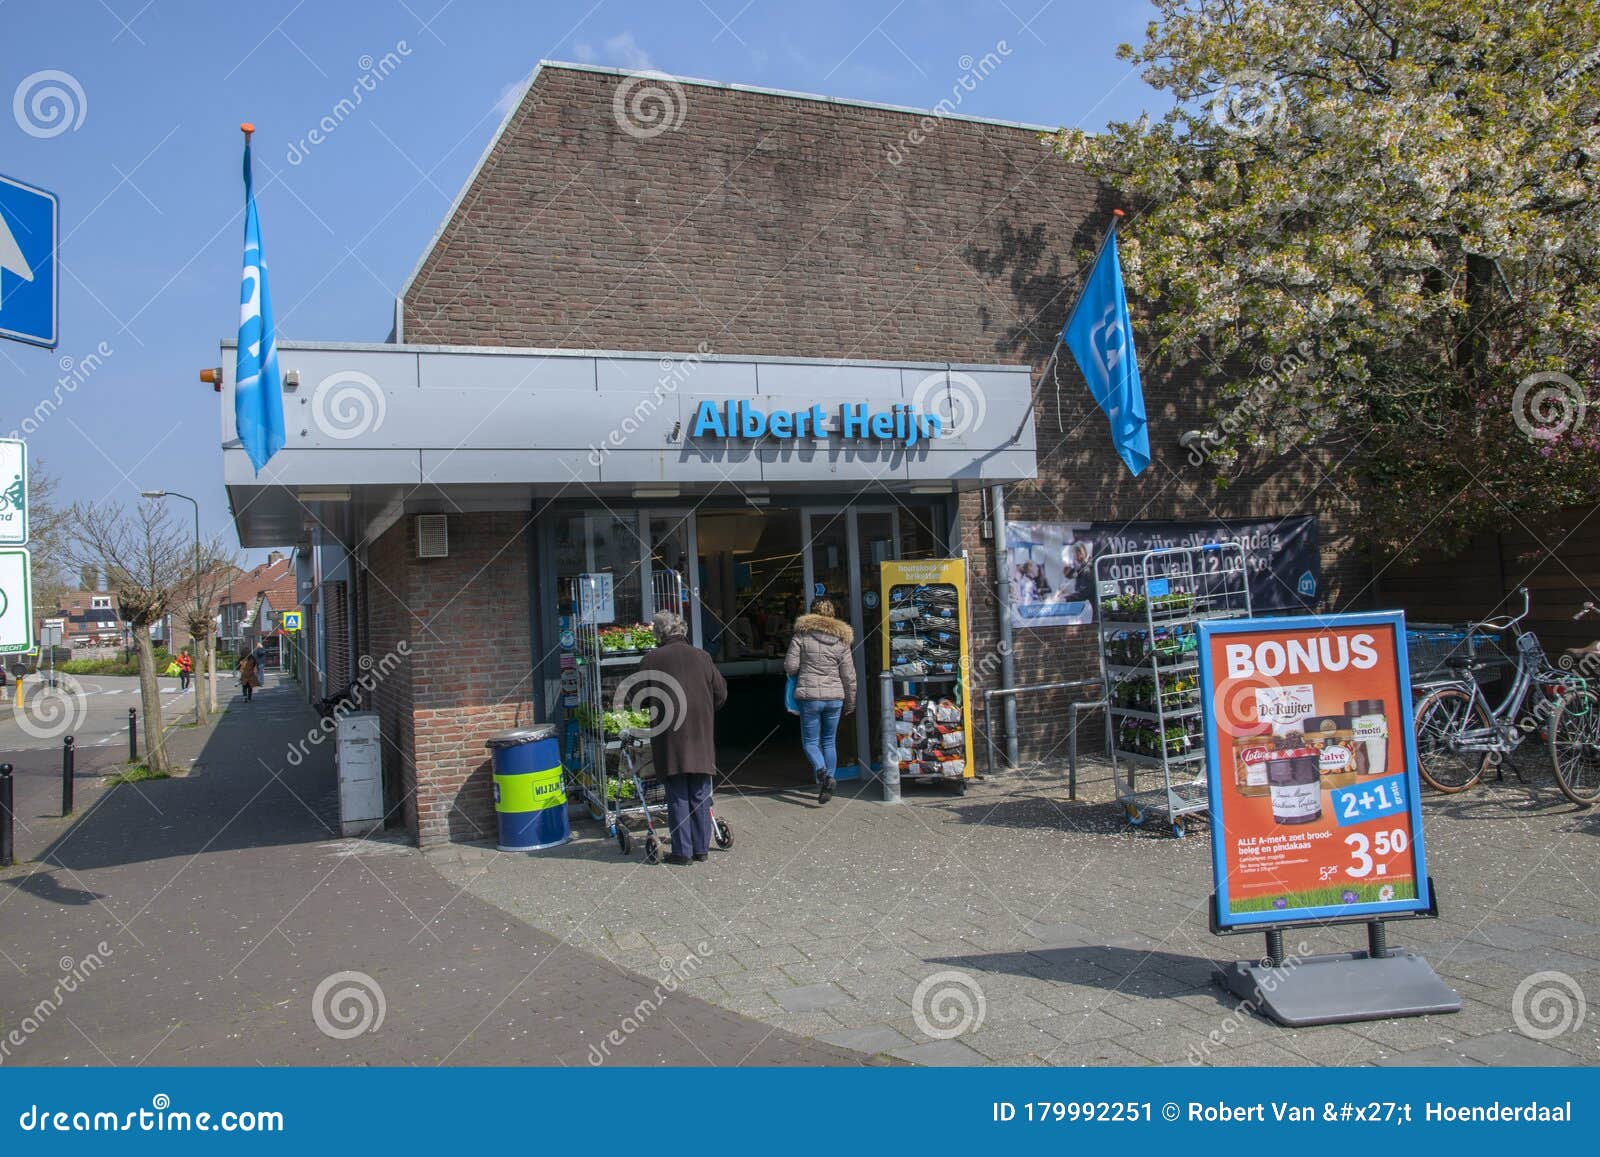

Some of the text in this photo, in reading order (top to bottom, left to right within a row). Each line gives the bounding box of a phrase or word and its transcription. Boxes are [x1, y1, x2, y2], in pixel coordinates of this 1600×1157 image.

[694, 400, 941, 447] Albert Heijn
[1107, 536, 1138, 554] We
[1225, 633, 1378, 679] BONUS
[1260, 701, 1313, 718] De Ruijter
[1341, 784, 1392, 819] 2+1
[1237, 829, 1333, 848] ALLE A-merk zoet brood-
[1261, 844, 1272, 854] en
[1273, 841, 1312, 854] pindakaas
